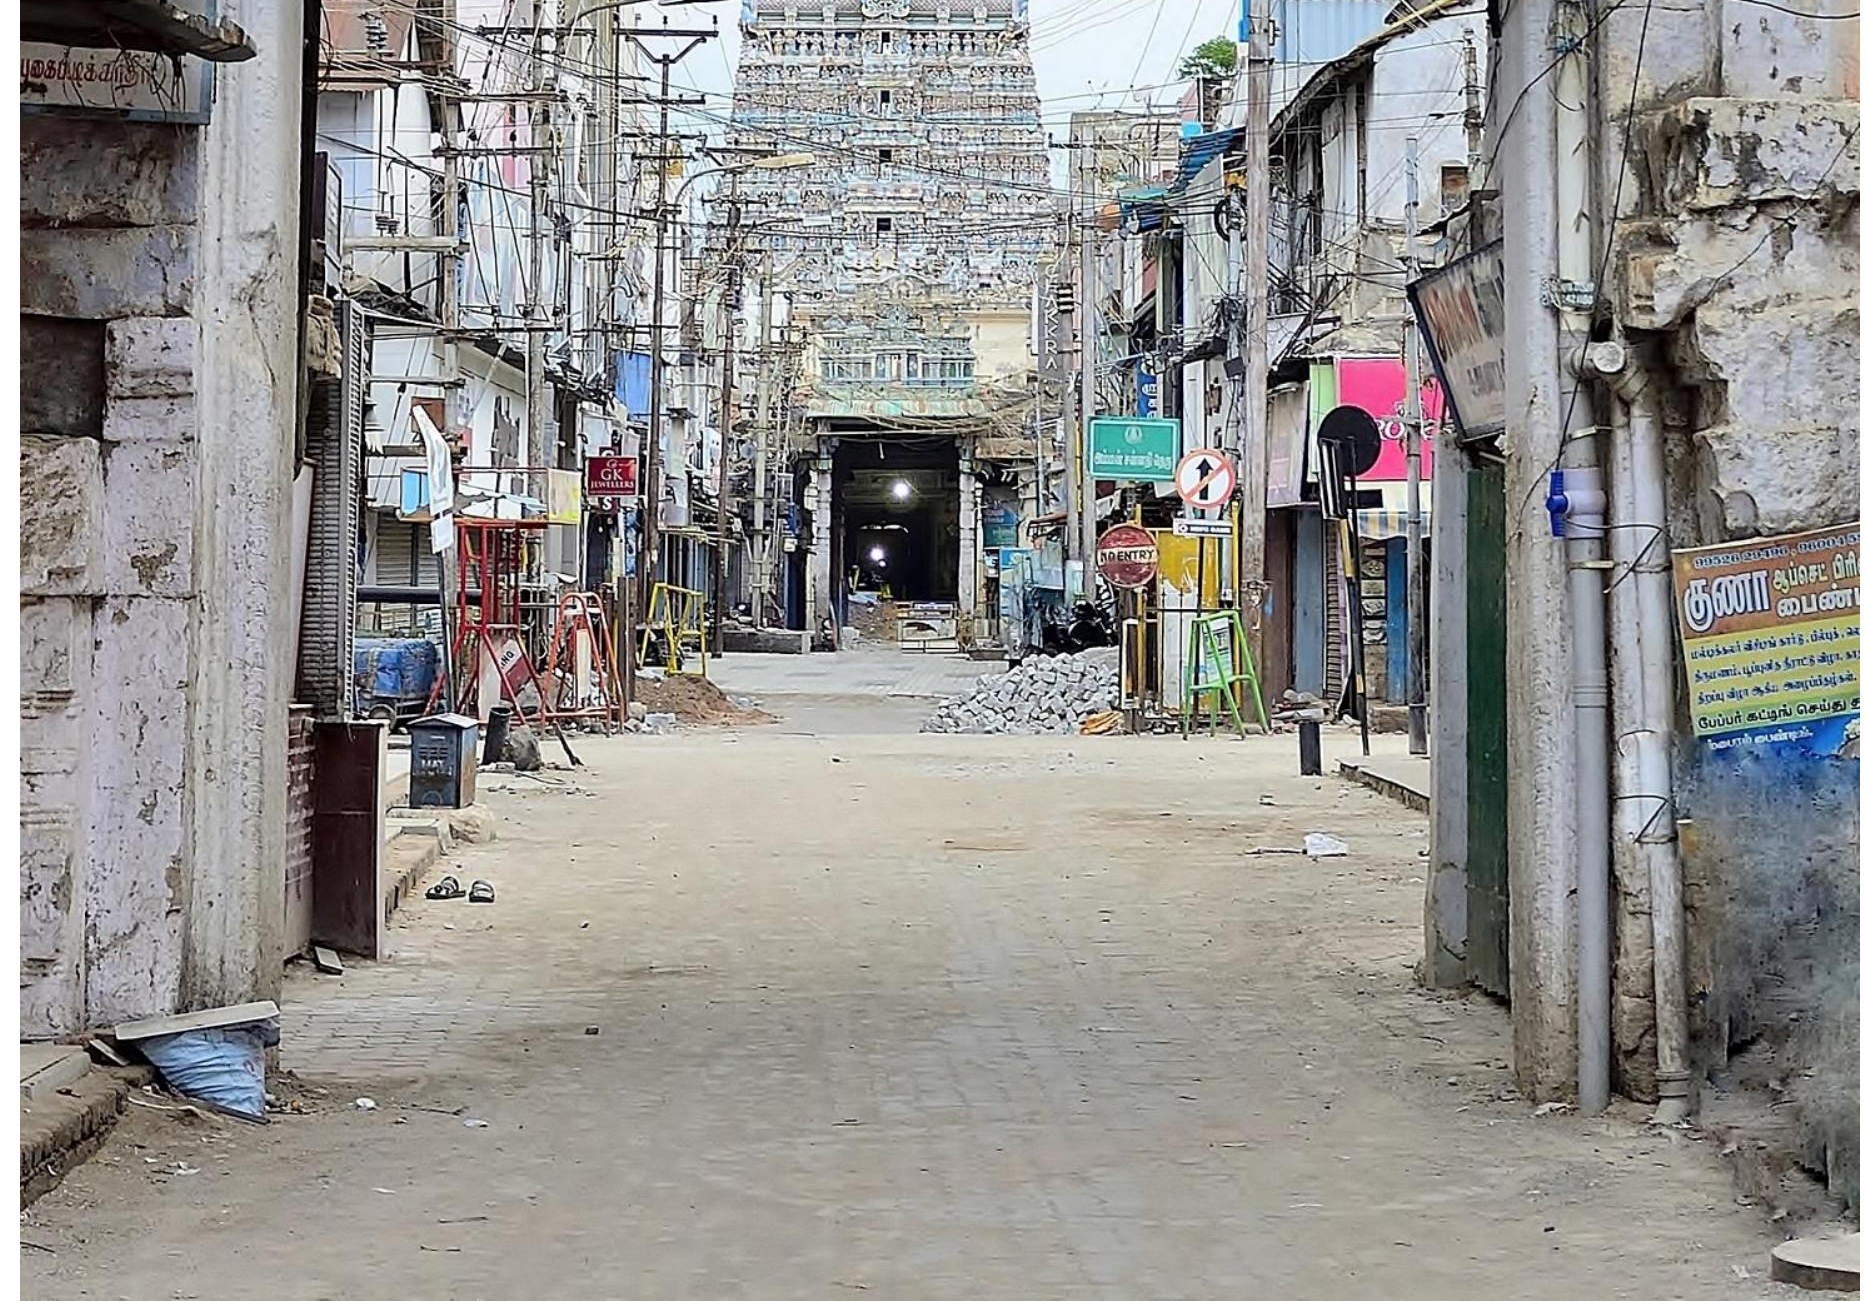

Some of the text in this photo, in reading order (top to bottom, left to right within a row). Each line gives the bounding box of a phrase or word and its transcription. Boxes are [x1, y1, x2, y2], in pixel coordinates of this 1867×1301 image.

[601, 468, 623, 480] GK
[591, 480, 634, 488] JEWELLERS
[1101, 549, 1155, 563] NO ENTRY
[1699, 710, 1742, 729] பேப்பர்
[1796, 698, 1846, 715] செய்து
